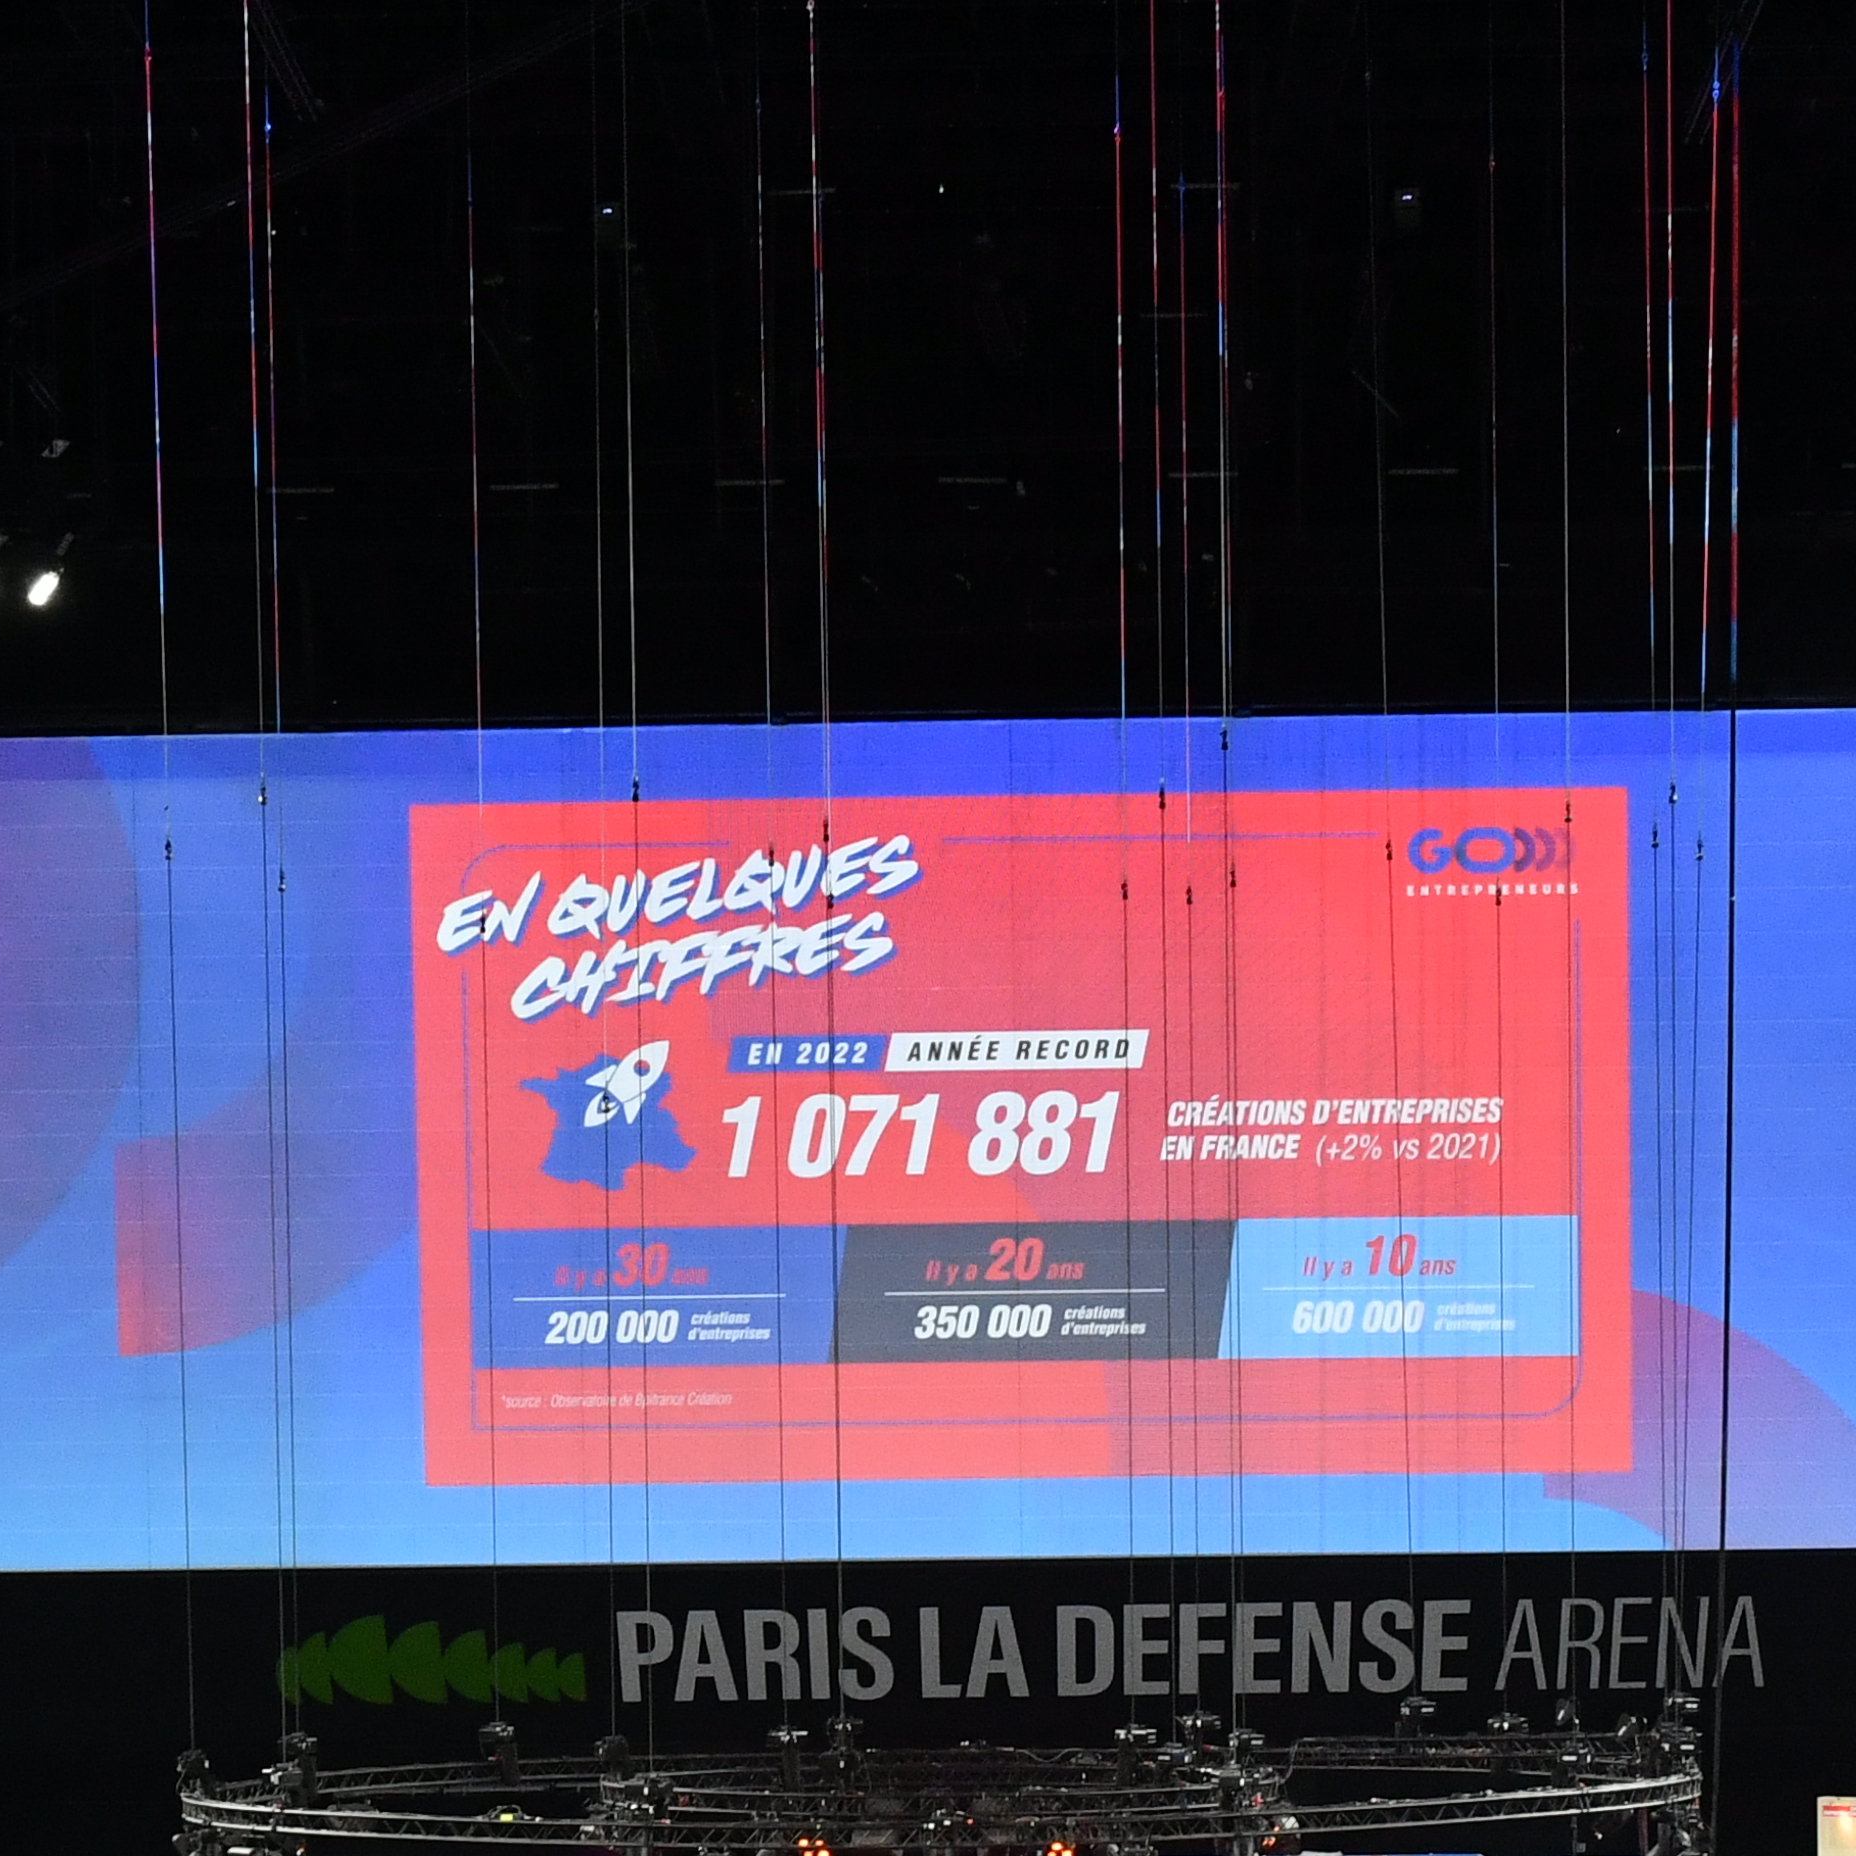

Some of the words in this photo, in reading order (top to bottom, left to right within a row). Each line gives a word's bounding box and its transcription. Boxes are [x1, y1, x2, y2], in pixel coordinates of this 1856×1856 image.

[1408, 827, 1515, 874] GO
[437, 871, 543, 953] EN
[547, 834, 922, 940] QUELQUES
[1407, 884, 1578, 896] ENTREPRENEURS
[511, 912, 896, 1021] CHIFFRES
[747, 1043, 782, 1066] EN
[797, 1042, 869, 1065] 2022
[907, 1034, 1003, 1063] ANNÉE
[1015, 1034, 1133, 1062] RECORD
[1166, 1094, 1305, 1128] CRÉATIONS
[1312, 1096, 1504, 1126] D'ENTREPRISES
[722, 1095, 761, 1178] 1
[787, 1093, 940, 1178] 071
[967, 1089, 1121, 1177] 881
[1160, 1137, 1193, 1161] EN
[1200, 1134, 1299, 1160] FRANCE
[1315, 1134, 1382, 1167] (+2%
[1392, 1139, 1420, 1159] vs
[1426, 1132, 1502, 1165] 2021)
[612, 1242, 671, 1288] 30
[984, 1237, 1044, 1282] 20
[1047, 1261, 1085, 1281] ans
[1364, 1233, 1419, 1278] 10
[1419, 1256, 1457, 1277] ans
[544, 1310, 608, 1345] 200
[615, 1309, 679, 1344] 000
[690, 1308, 751, 1326] créations
[914, 1305, 978, 1340] 350
[986, 1304, 1052, 1339] 000
[1060, 1320, 1147, 1338] d'entreprises
[1063, 1304, 1126, 1320] créations
[1292, 1300, 1353, 1334] 600
[1362, 1300, 1425, 1334] 000
[687, 1325, 771, 1343] d'entreprises
[616, 1606, 893, 1703] PARIS
[920, 1606, 1031, 1699] LA
[1057, 1600, 1470, 1696] DEFENSE
[1496, 1595, 1766, 1692] ARENA
